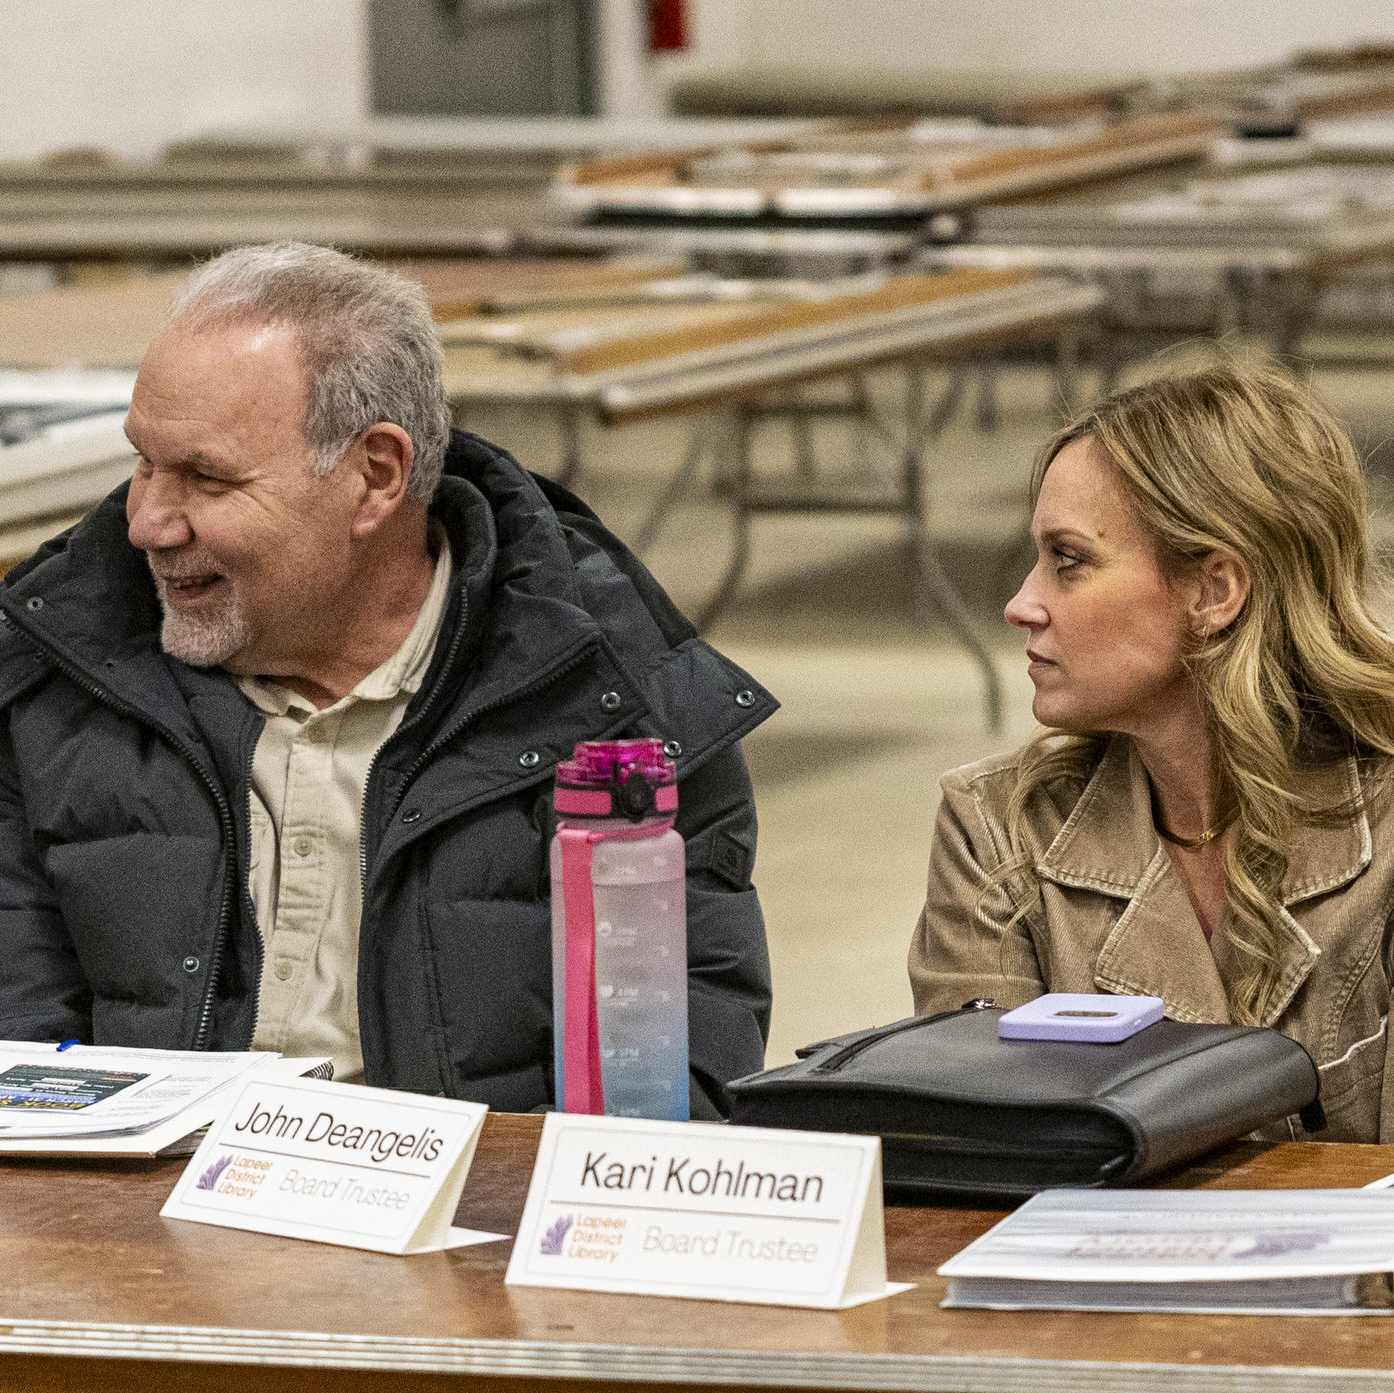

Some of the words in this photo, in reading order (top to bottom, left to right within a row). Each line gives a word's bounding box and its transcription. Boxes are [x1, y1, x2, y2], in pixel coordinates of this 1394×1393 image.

[235, 1102, 304, 1139] John
[306, 1112, 444, 1163] Deangelis
[232, 1156, 274, 1173] Lapeer
[224, 1168, 266, 1186] District
[580, 1151, 658, 1192] Kari
[664, 1157, 824, 1203] Kohlman
[217, 1181, 258, 1201] Library
[279, 1168, 338, 1199] Board
[342, 1176, 410, 1211] Trustee
[576, 1214, 628, 1230] Lapeer
[571, 1229, 623, 1246] District
[643, 1225, 721, 1257] Board
[727, 1230, 819, 1263] Trustee
[567, 1245, 620, 1264] Library
